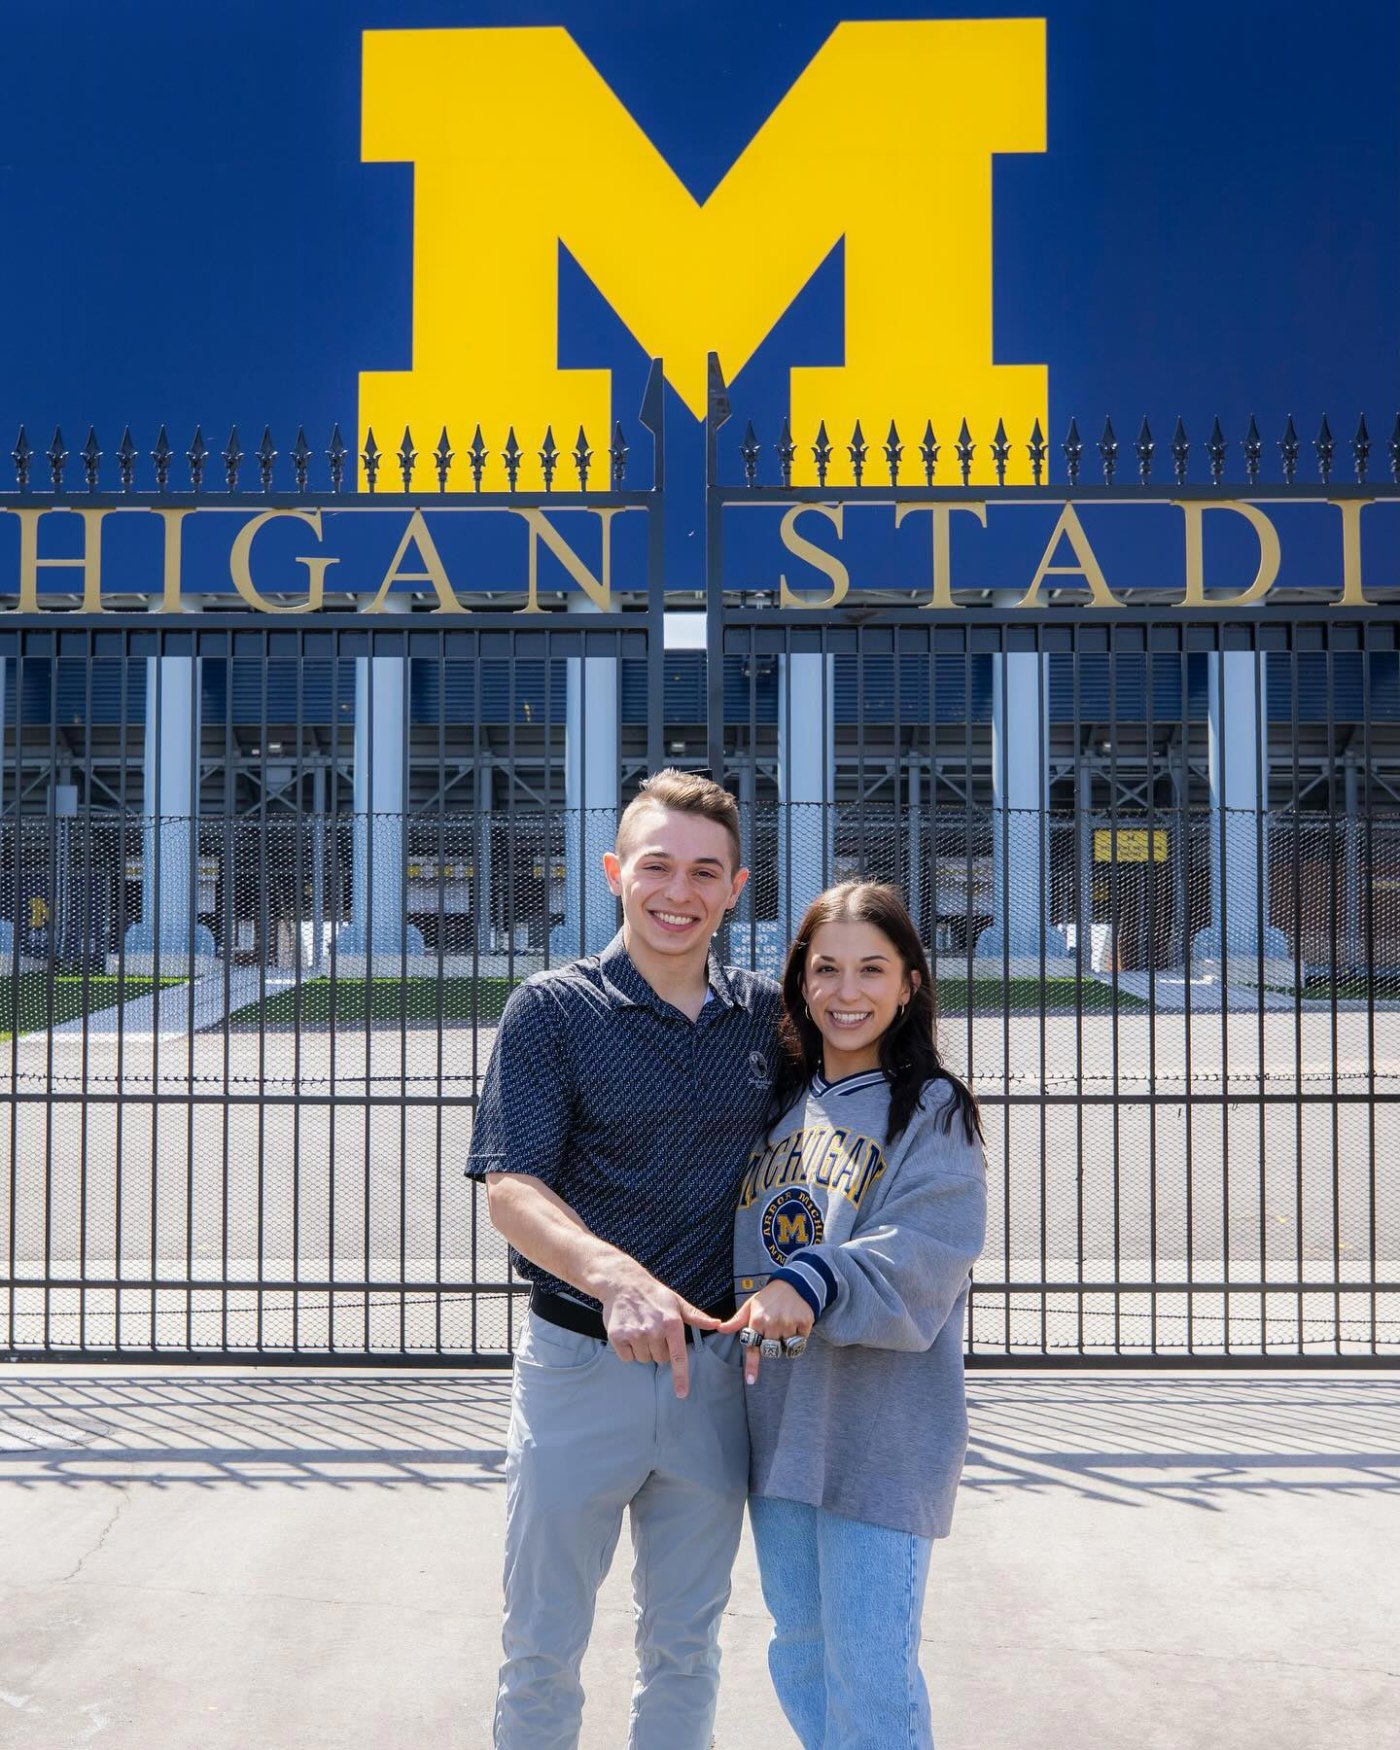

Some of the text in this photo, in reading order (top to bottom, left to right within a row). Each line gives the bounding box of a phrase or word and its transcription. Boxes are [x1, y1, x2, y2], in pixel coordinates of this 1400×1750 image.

[359, 17, 1049, 493] M
[7, 500, 1378, 614] HIGAN STADI
[777, 1213, 809, 1244] M
